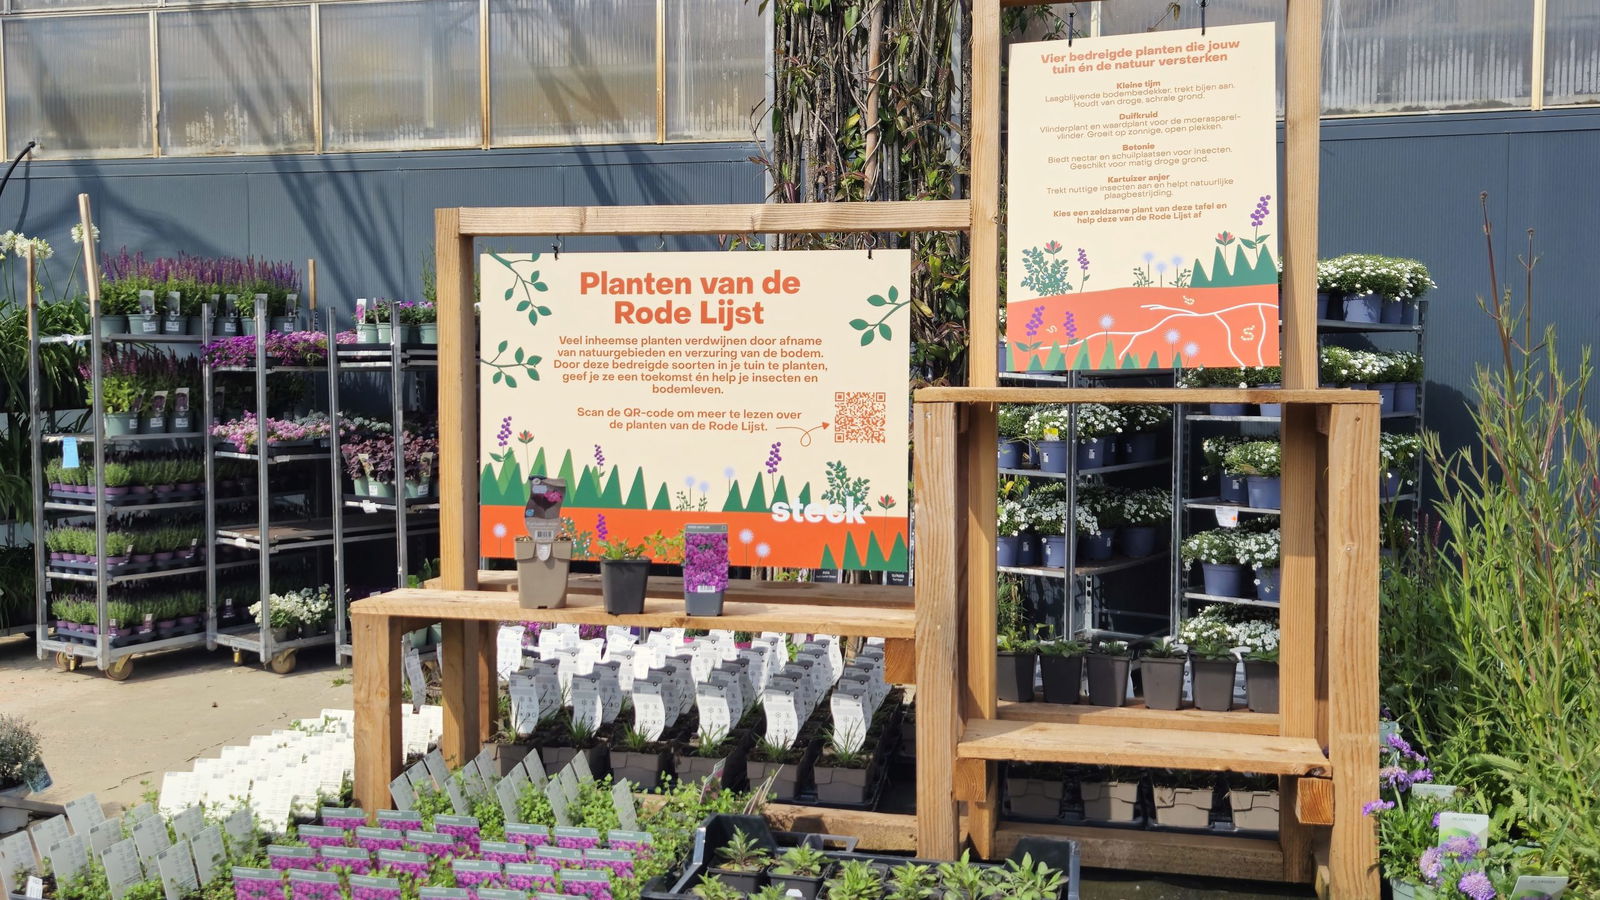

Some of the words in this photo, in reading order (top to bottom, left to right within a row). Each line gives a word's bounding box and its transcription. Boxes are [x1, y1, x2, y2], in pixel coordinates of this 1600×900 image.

[1041, 53, 1066, 64] Vier
[1069, 47, 1133, 62] bedreigde
[1135, 44, 1183, 59] planten
[1185, 41, 1206, 52] die
[1208, 40, 1240, 53] jouw
[1052, 63, 1076, 74] tuin
[1078, 62, 1093, 72] én
[1096, 61, 1112, 71] de
[1114, 58, 1156, 70] natuur
[1158, 52, 1228, 66] versterken
[1116, 81, 1143, 90] Kleine
[1144, 80, 1161, 89] tijm
[1045, 92, 1101, 103] Laagblijvende
[1174, 85, 1194, 93] trekt
[1195, 84, 1217, 92] bijen
[1073, 100, 1099, 108] Houdt
[1145, 94, 1176, 103] schrale
[1119, 110, 1159, 120] Duifkruid
[1039, 124, 1088, 134] Vlinderplant
[1102, 120, 1148, 129] waardplant
[1086, 130, 1114, 138] Groeit
[1122, 143, 1155, 151] Betonie
[1048, 156, 1070, 164] Biedt
[1071, 154, 1097, 162] nectar
[1111, 150, 1172, 160] schuilplaatsen
[1069, 161, 1106, 170] Geschikt
[1128, 159, 1153, 167] matig
[1107, 175, 1147, 184] Kartuizer
[1148, 173, 1170, 182] anjer
[1047, 187, 1067, 195] Trekt
[1068, 185, 1098, 194] nuttige
[1099, 183, 1136, 192] insecten
[1166, 180, 1188, 189] helpt
[1190, 178, 1234, 187] natuurlijke
[1090, 207, 1130, 215] zeldzame
[1131, 205, 1153, 215] plant
[1194, 202, 1215, 210] tafel
[1076, 216, 1096, 225] help
[1173, 212, 1192, 221] Lijst
[580, 270, 692, 294] Planten
[699, 276, 754, 294] van
[762, 269, 801, 294] de
[614, 300, 692, 324] Rode
[700, 300, 764, 331] Lijst
[559, 335, 582, 346] Veel
[585, 335, 638, 346] inheemse
[640, 335, 682, 348] planten
[684, 335, 747, 348] verdwijnen
[749, 335, 777, 346] door
[779, 335, 822, 346] afname
[578, 347, 666, 360] natuurgebieden
[684, 347, 738, 360] verzuring
[762, 347, 778, 358] de
[780, 348, 824, 358] bodem.
[553, 359, 580, 369] Door
[582, 359, 610, 370] deze
[612, 359, 669, 372] bedreigde
[671, 359, 715, 370] soorten
[717, 360, 728, 370] in
[730, 360, 741, 372] je
[743, 360, 765, 370] tuin
[767, 360, 780, 370] te
[782, 360, 828, 373] planten,
[562, 371, 587, 384] geef
[589, 371, 600, 384] je
[640, 371, 693, 382] toekomst
[695, 372, 710, 382] én
[712, 372, 736, 385] help
[738, 372, 750, 385] je
[752, 372, 801, 382] insecten
[652, 384, 724, 395] bodemleven.
[577, 407, 604, 417] Scan
[606, 407, 621, 417] de
[623, 407, 674, 418] QR-code
[729, 408, 741, 418] te
[743, 408, 774, 419] lezen
[609, 419, 624, 430] de
[626, 419, 667, 432] planten
[691, 420, 706, 430] de
[708, 420, 739, 431] Rode
[741, 420, 768, 434] Lijst.
